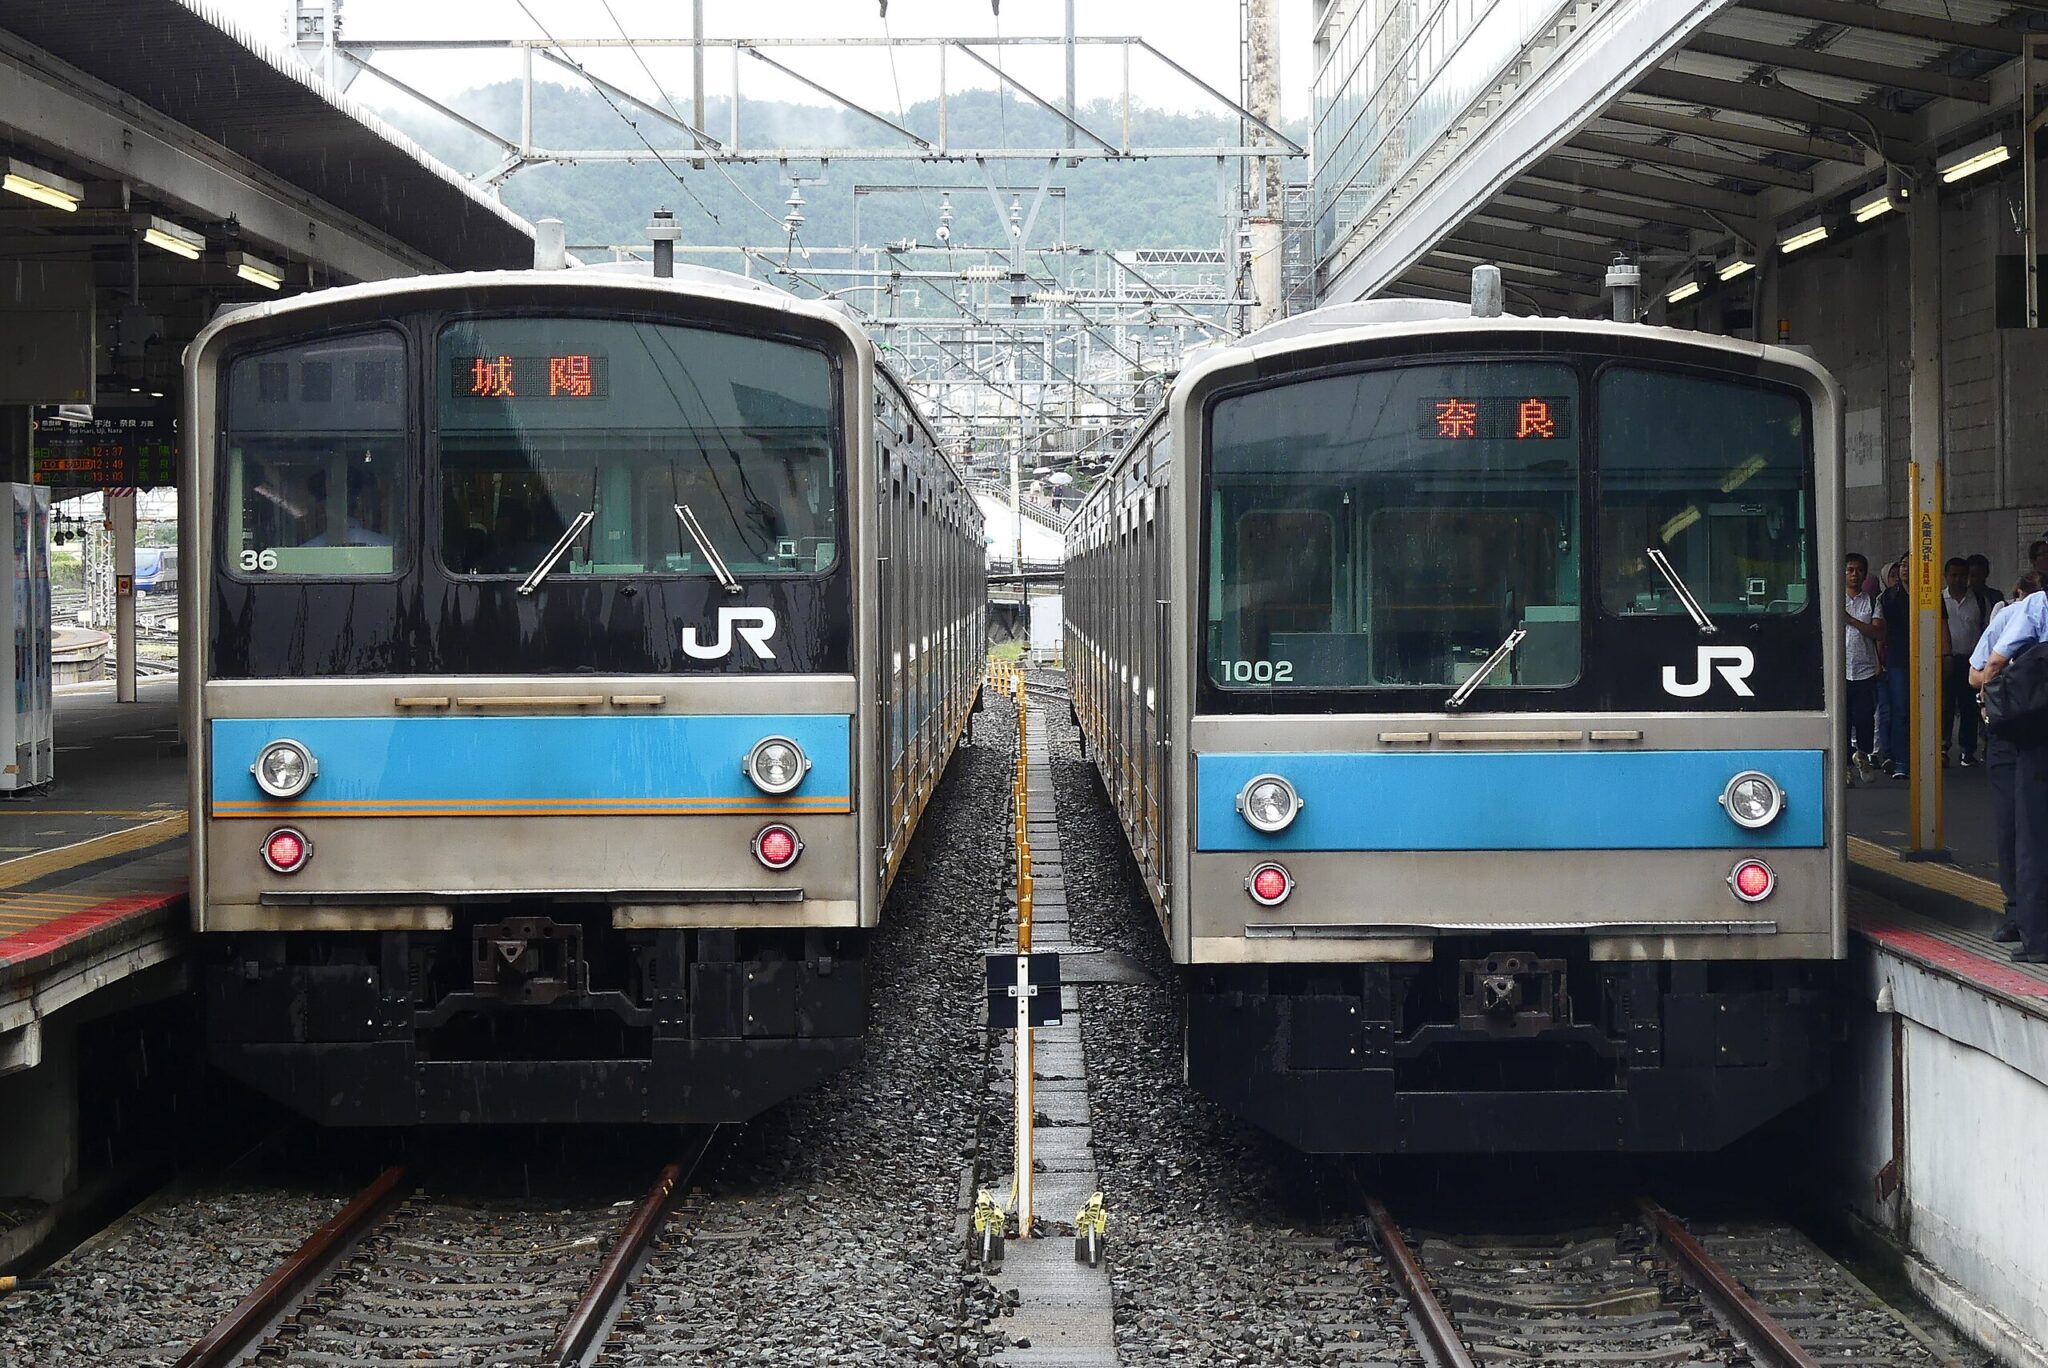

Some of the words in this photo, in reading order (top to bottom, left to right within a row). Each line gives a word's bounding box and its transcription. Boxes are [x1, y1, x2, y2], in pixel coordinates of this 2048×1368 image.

[92, 446, 123, 457] 12:37
[93, 459, 123, 470] 12:49
[92, 471, 124, 481] 13:03
[239, 549, 278, 571] 36
[141, 615, 154, 625] 35
[682, 606, 777, 660] JR
[1220, 660, 1294, 682] 1002
[1662, 645, 1755, 698] JR
